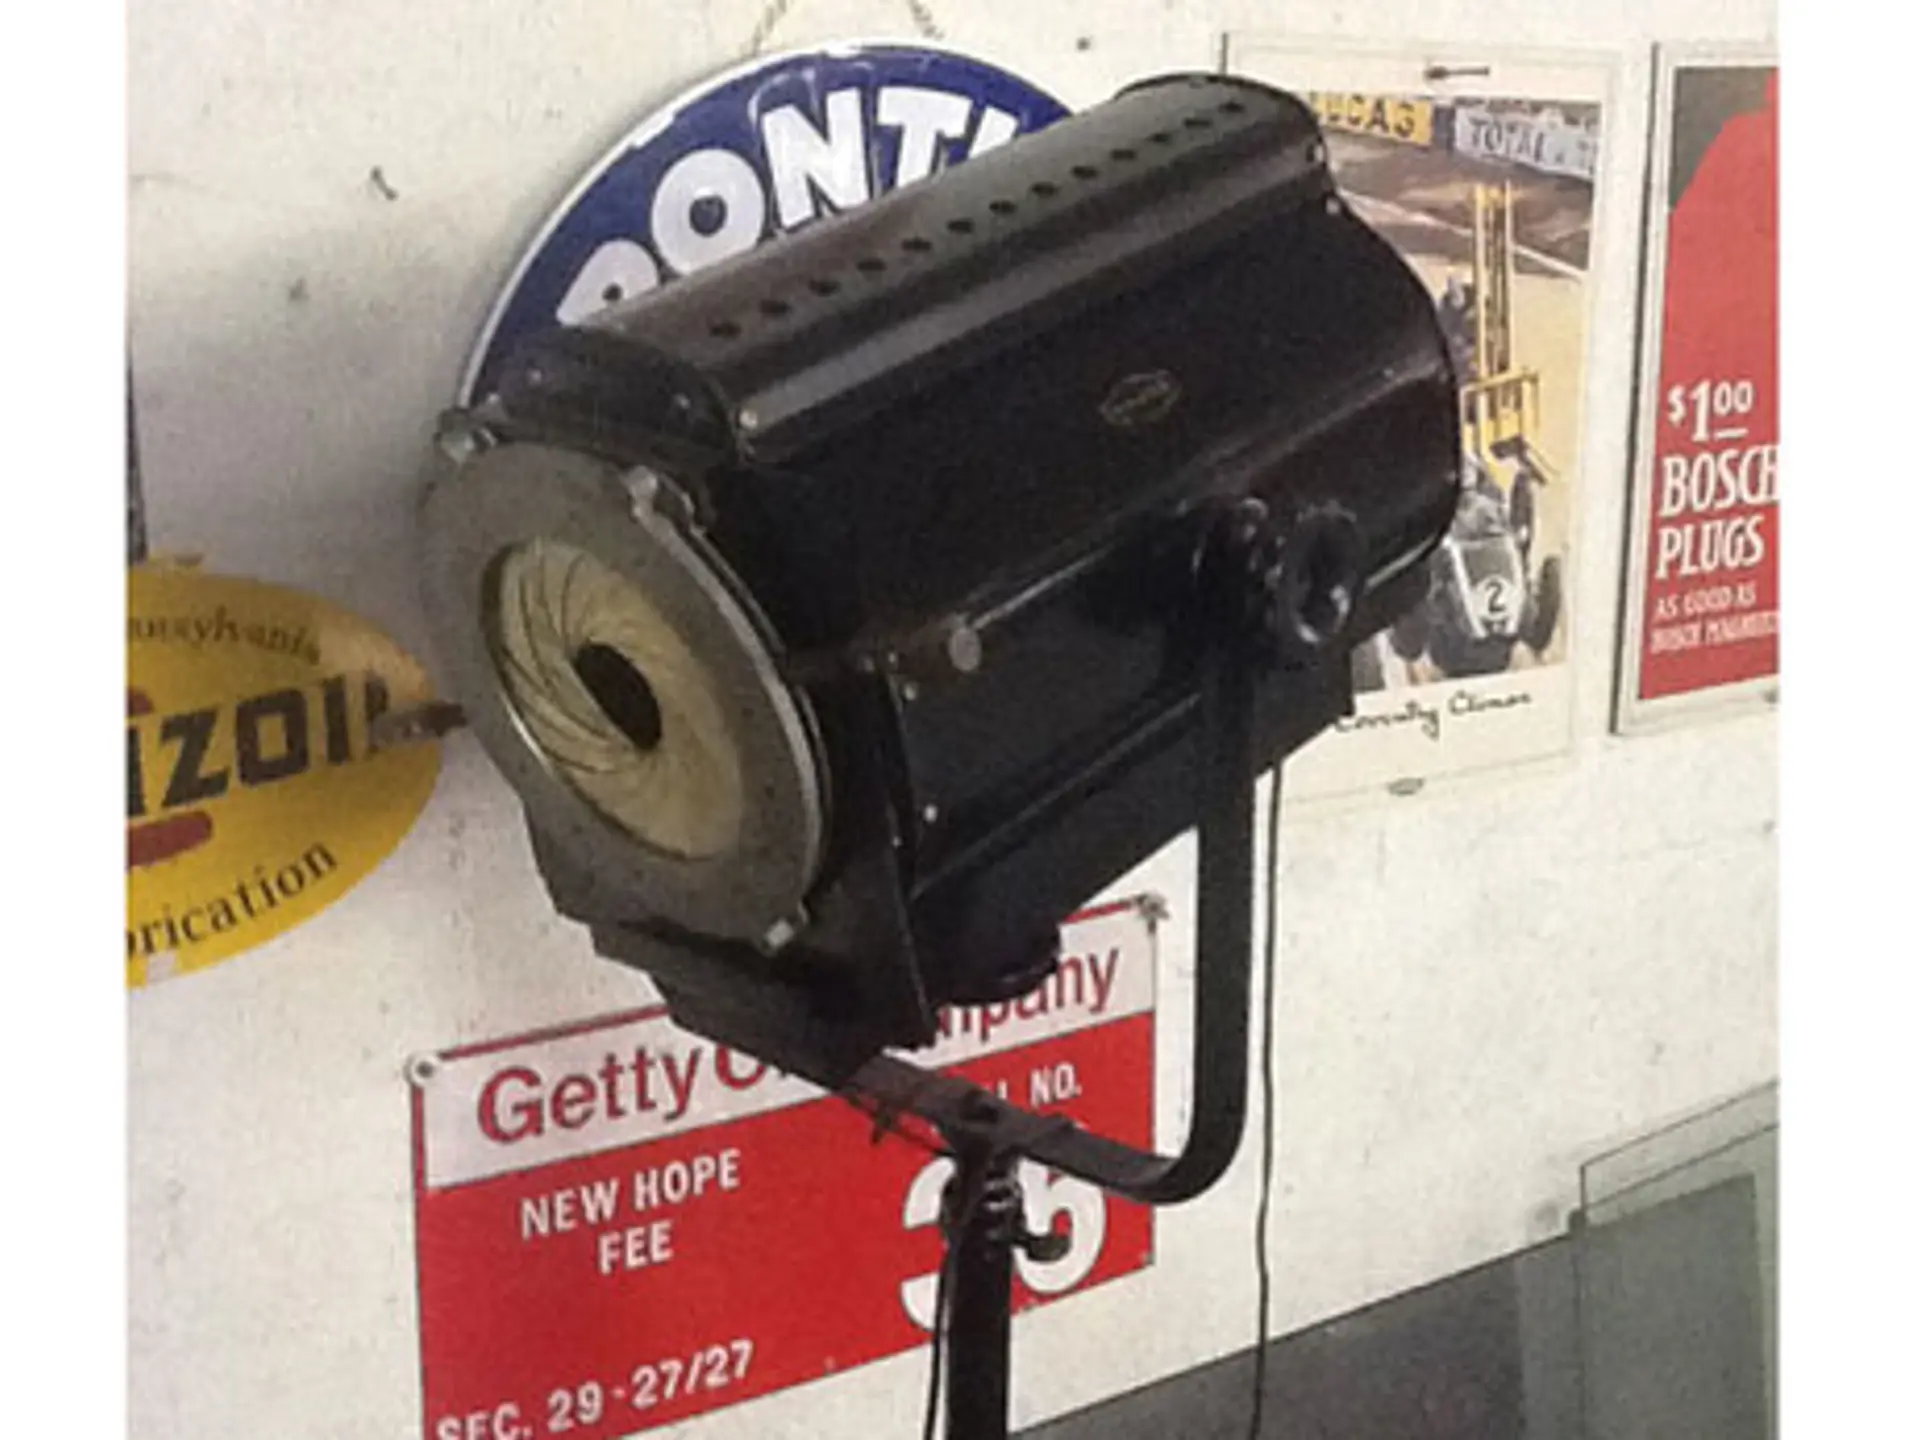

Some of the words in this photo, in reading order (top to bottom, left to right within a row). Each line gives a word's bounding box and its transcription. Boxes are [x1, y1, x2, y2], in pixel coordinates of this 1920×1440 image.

[1659, 443, 1780, 519] BOSCH
[1655, 515, 1766, 580] PLUGS
[1486, 581, 1506, 614] 2
[477, 1046, 703, 1144] Getty
[1030, 1063, 1083, 1108] NO.
[521, 1177, 618, 1241] NEW
[634, 1148, 741, 1211] HOPE
[599, 1220, 674, 1275] FEE
